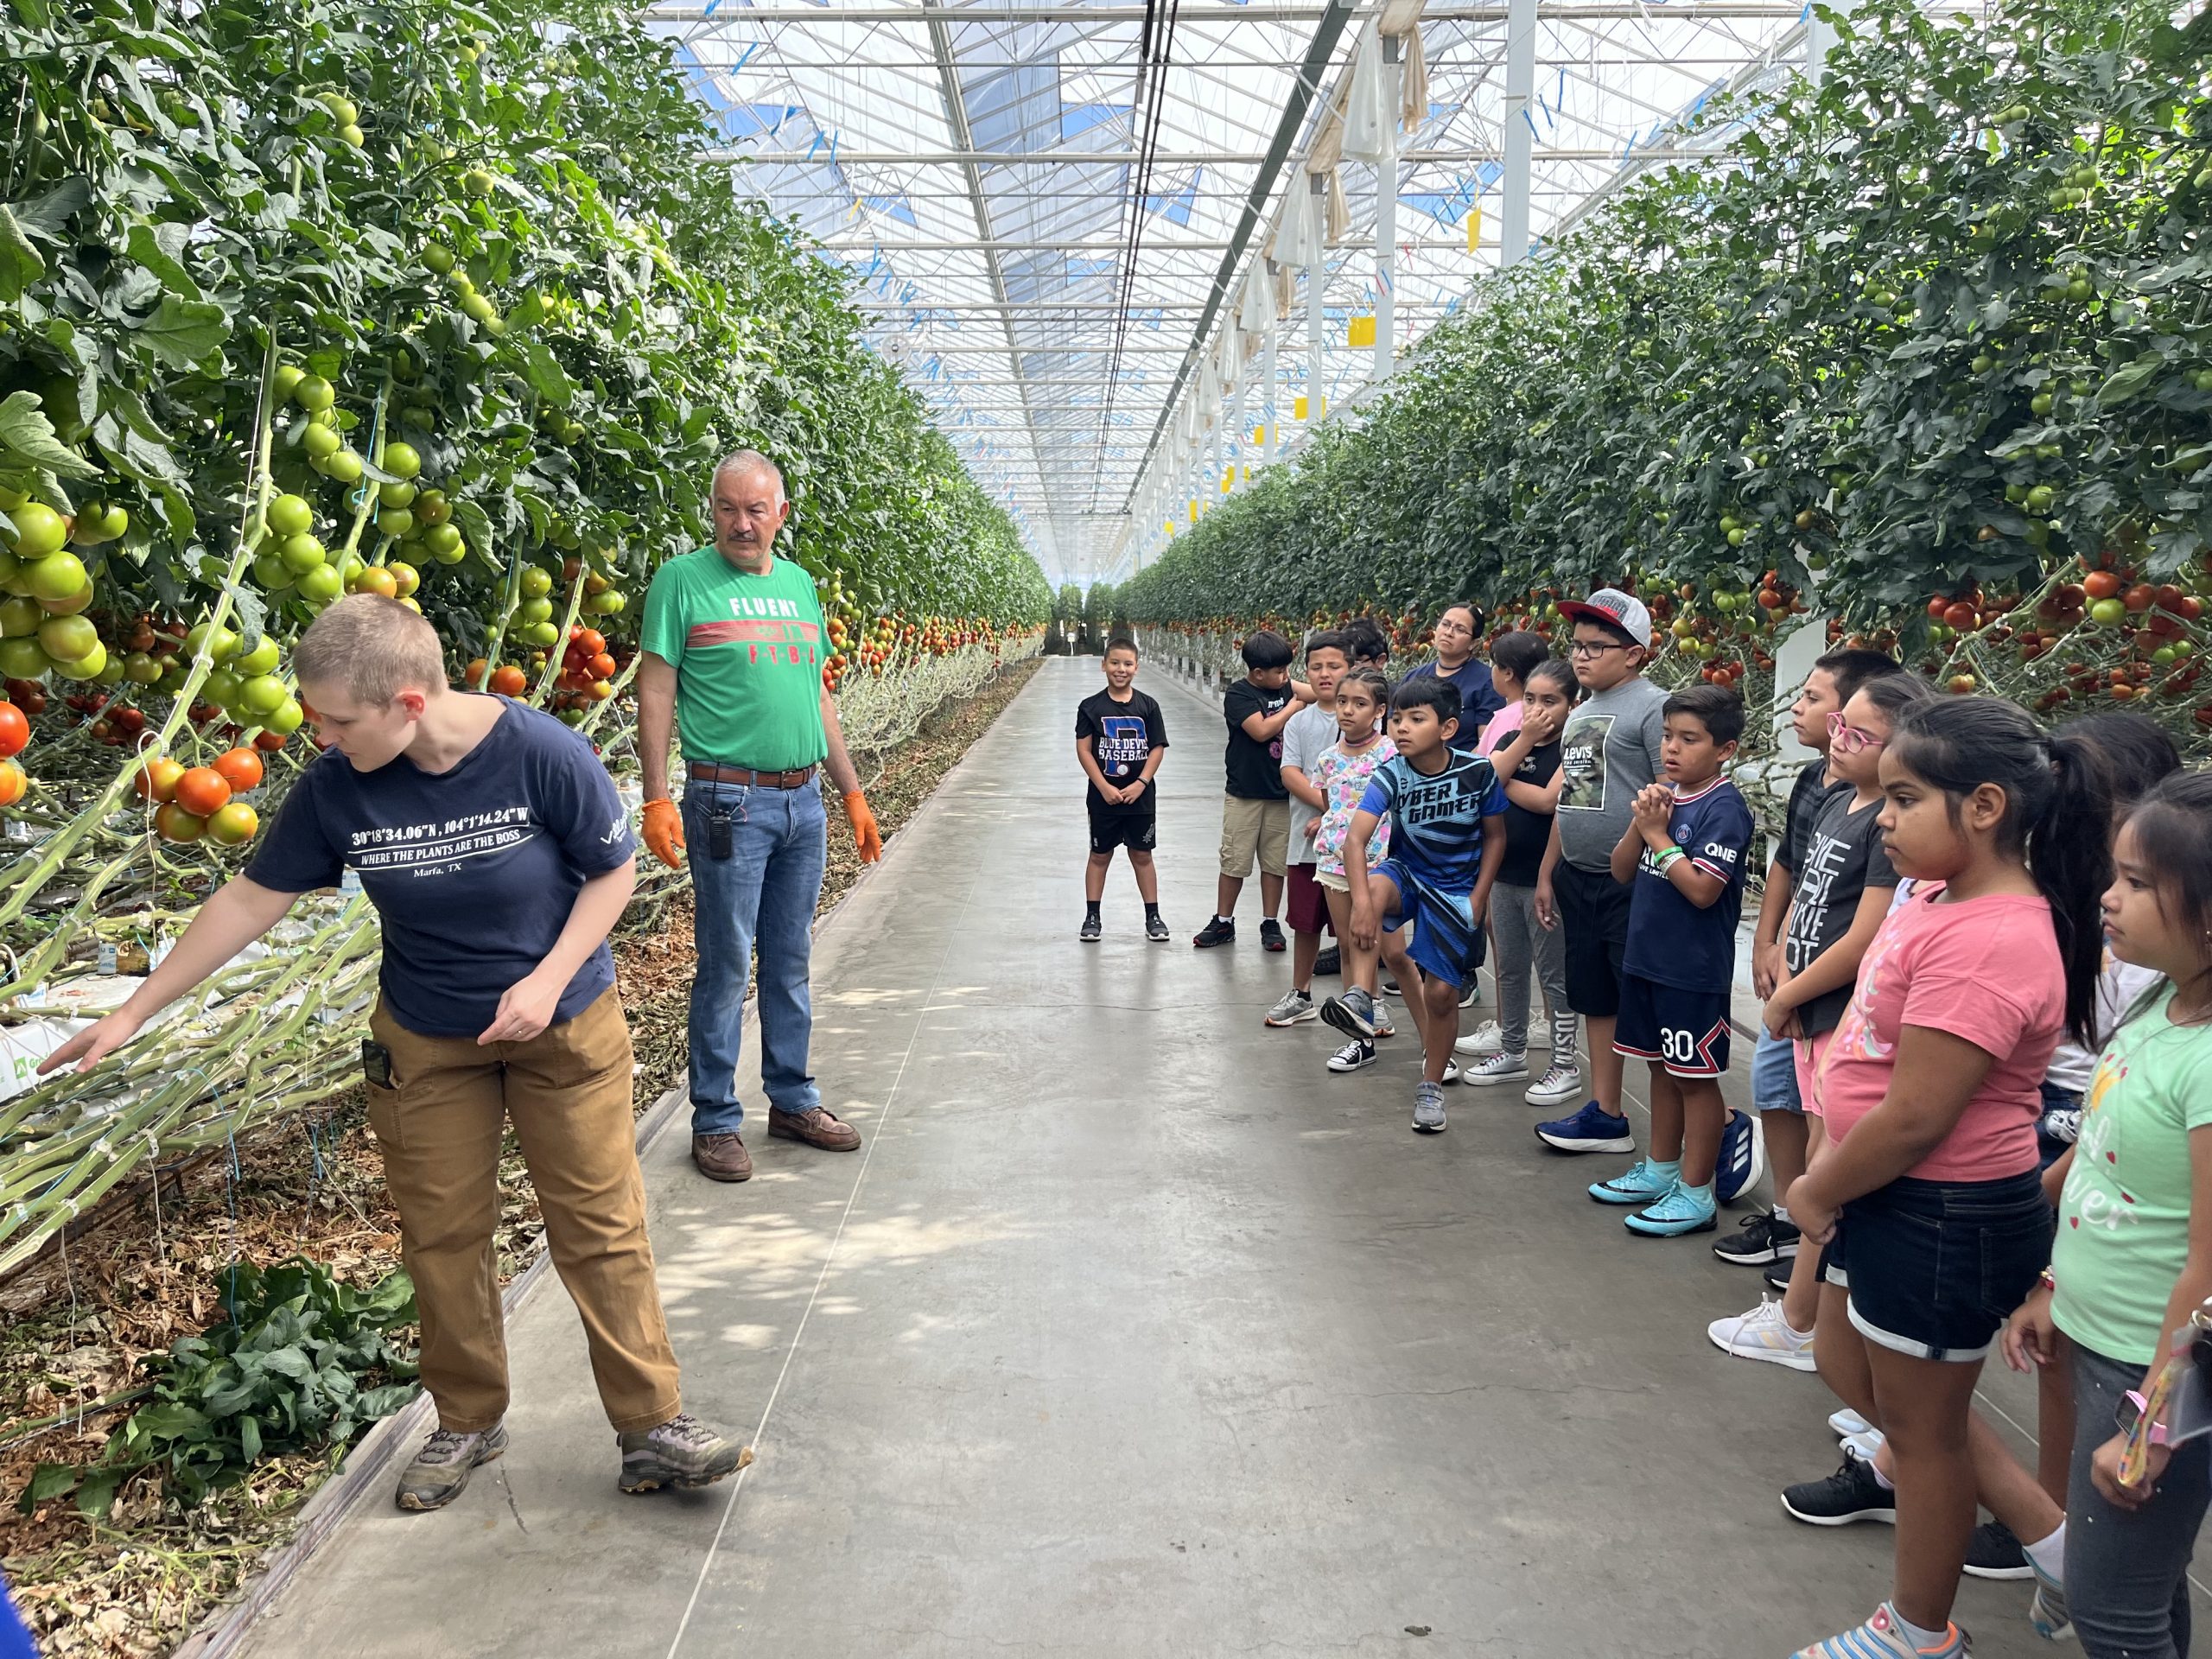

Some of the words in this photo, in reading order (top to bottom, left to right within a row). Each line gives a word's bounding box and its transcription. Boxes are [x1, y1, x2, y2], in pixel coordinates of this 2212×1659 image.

[728, 597, 799, 618] FLUENT
[1098, 736, 1122, 750] BLUE
[1098, 748, 1148, 761] BASEBALL
[1408, 795, 1481, 823] GAMER
[361, 852, 391, 865] WHERE
[392, 849, 415, 862] THE
[416, 844, 454, 860] PLANTS
[454, 839, 472, 854] ARE
[474, 835, 495, 848] THE
[495, 829, 520, 845] BOSS
[1704, 842, 1738, 863] QNB
[413, 867, 444, 878] Marfa,
[447, 862, 461, 873] TX
[1785, 936, 1819, 971] OT
[1660, 1027, 1694, 1062] 30
